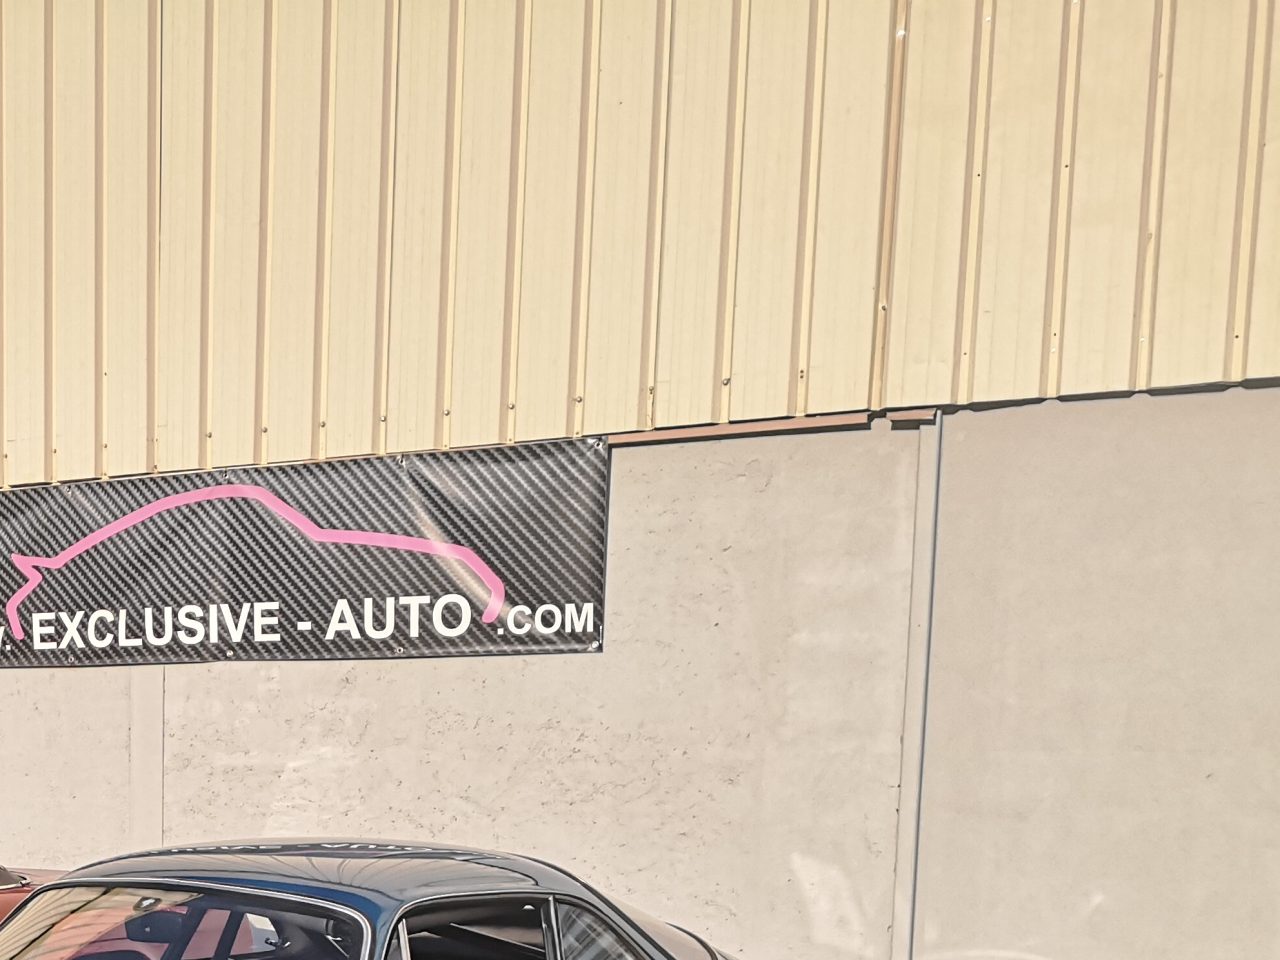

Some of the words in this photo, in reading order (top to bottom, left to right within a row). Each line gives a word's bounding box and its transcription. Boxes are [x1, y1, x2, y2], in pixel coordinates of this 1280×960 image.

[31, 601, 281, 650] EXCLUSIVE
[324, 594, 472, 640] AUTO
[497, 602, 594, 635] .COM
